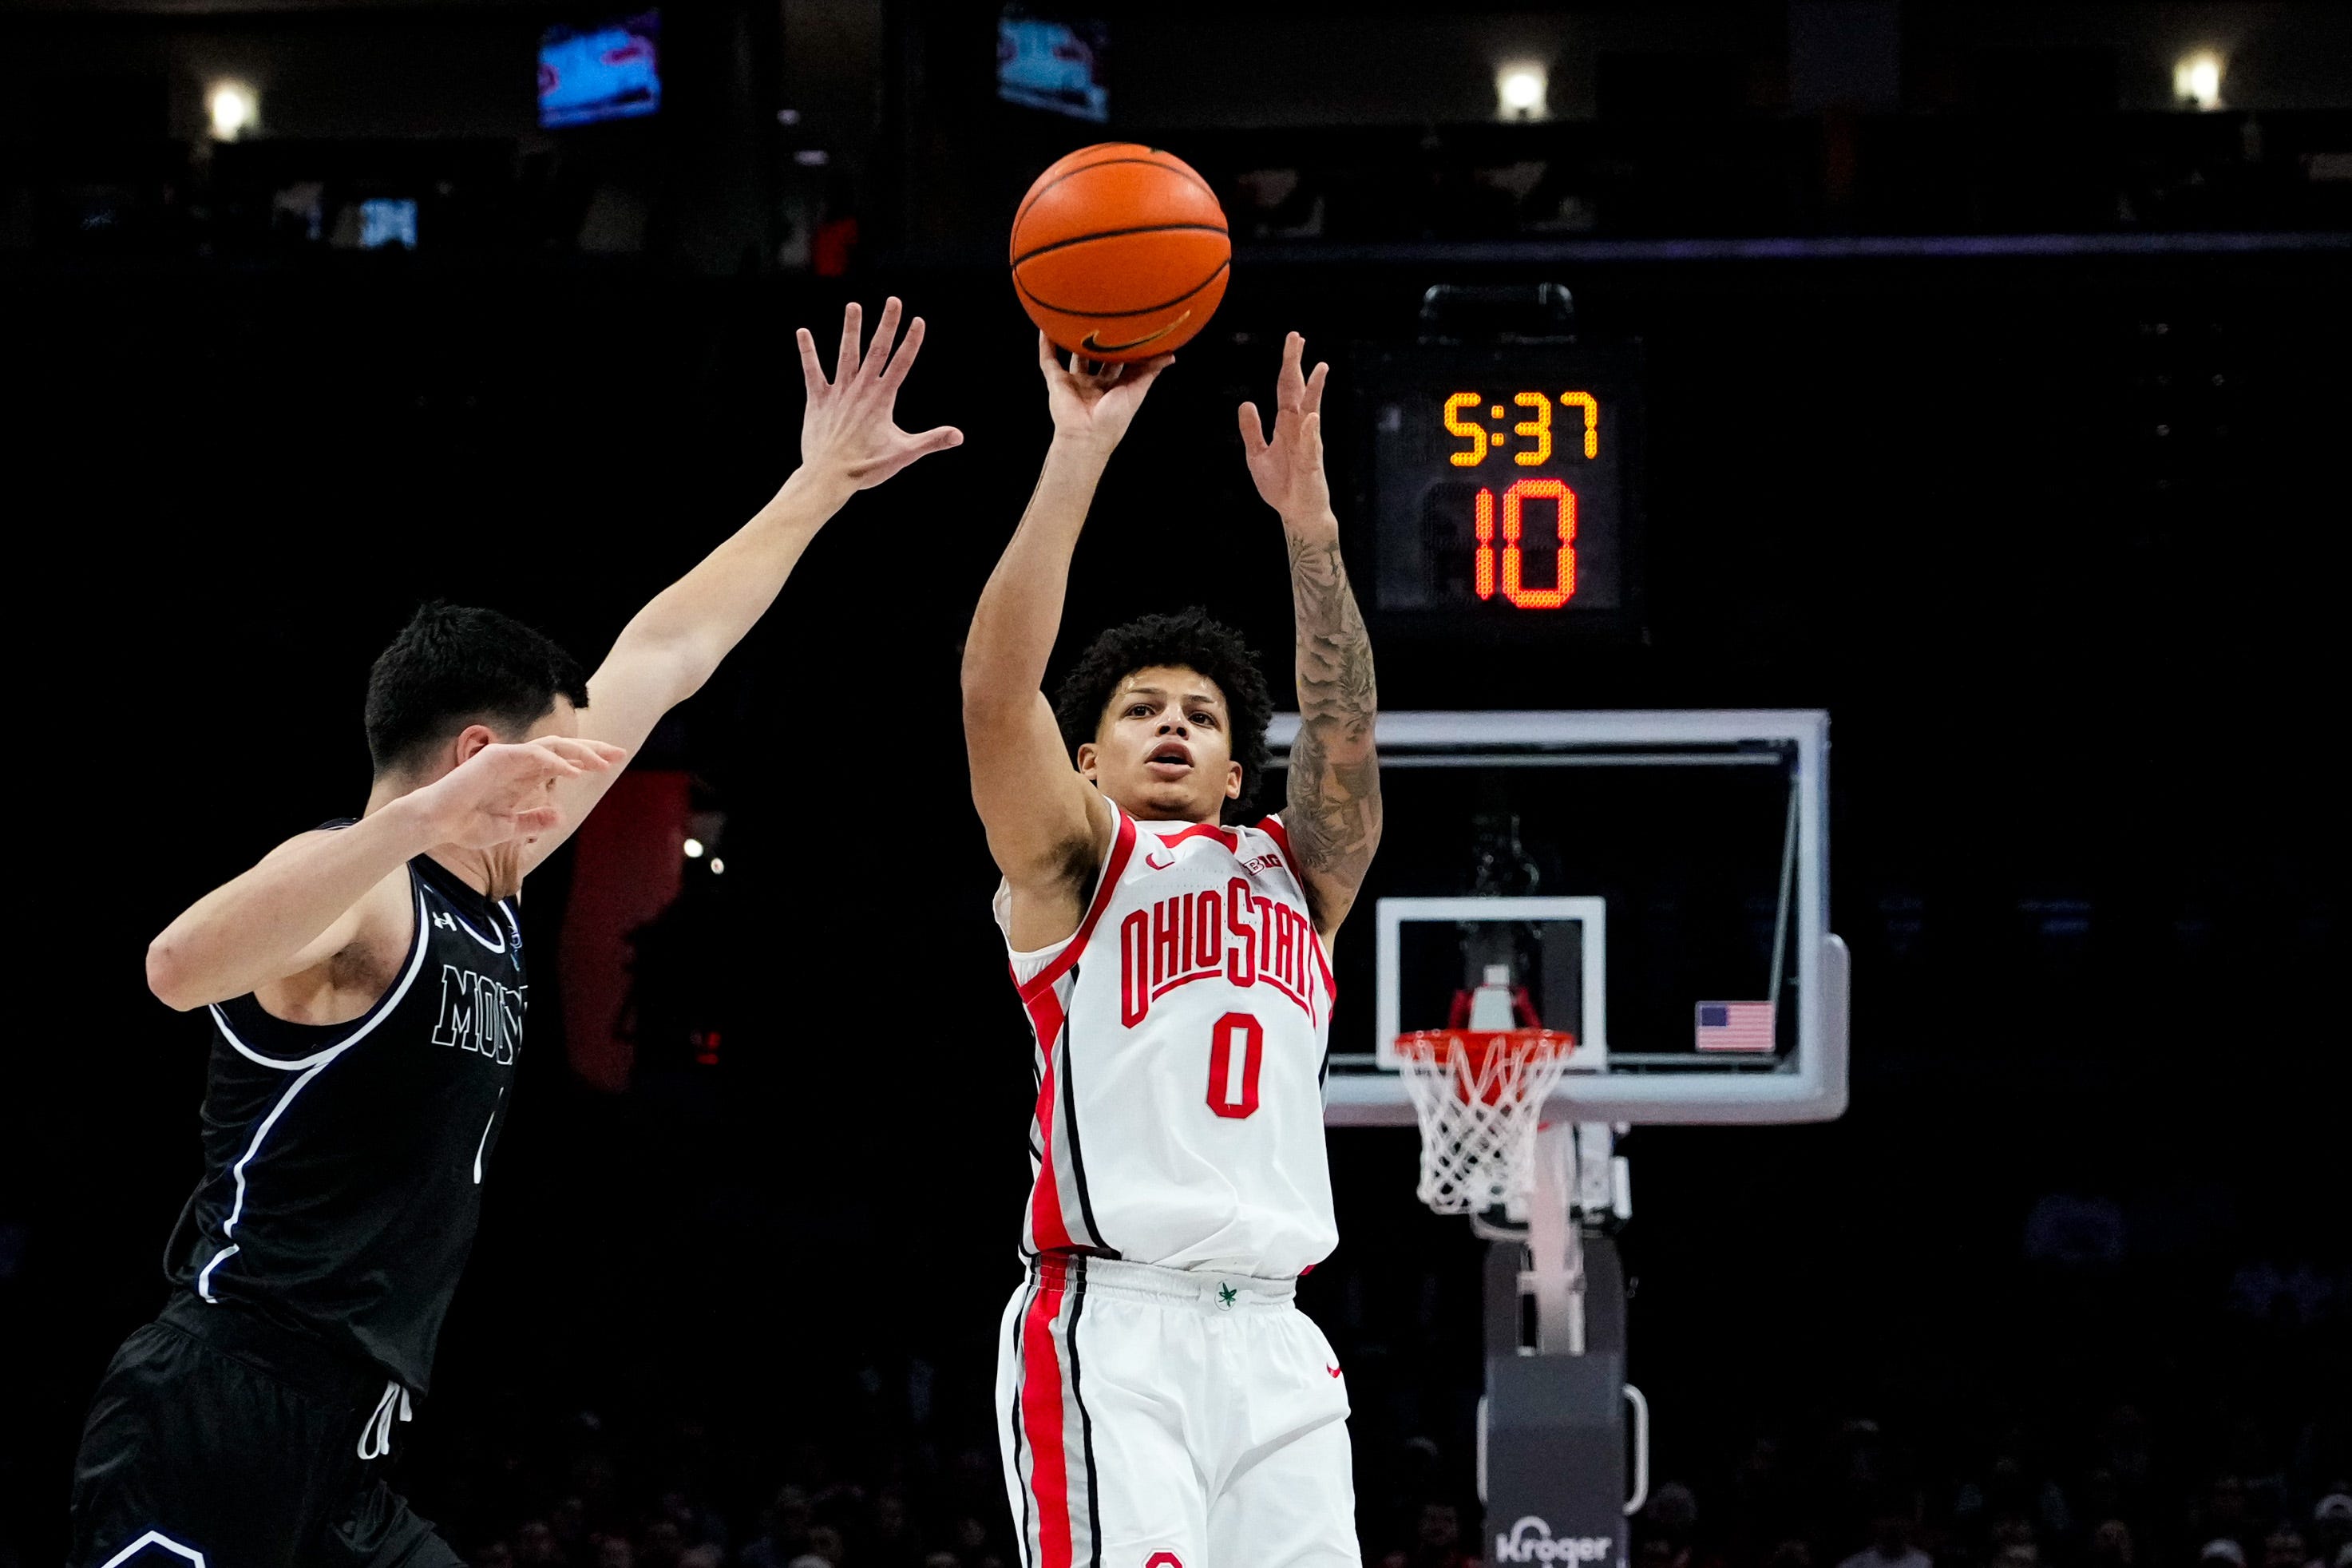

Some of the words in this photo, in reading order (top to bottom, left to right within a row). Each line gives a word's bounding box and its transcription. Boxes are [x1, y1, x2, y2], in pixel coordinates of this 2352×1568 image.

[1444, 391, 1597, 466] 5:37
[1475, 478, 1578, 609] 10
[1228, 877, 1317, 1031] STAT
[1206, 1012, 1263, 1119] 0
[1495, 1515, 1613, 1568] Kroger
